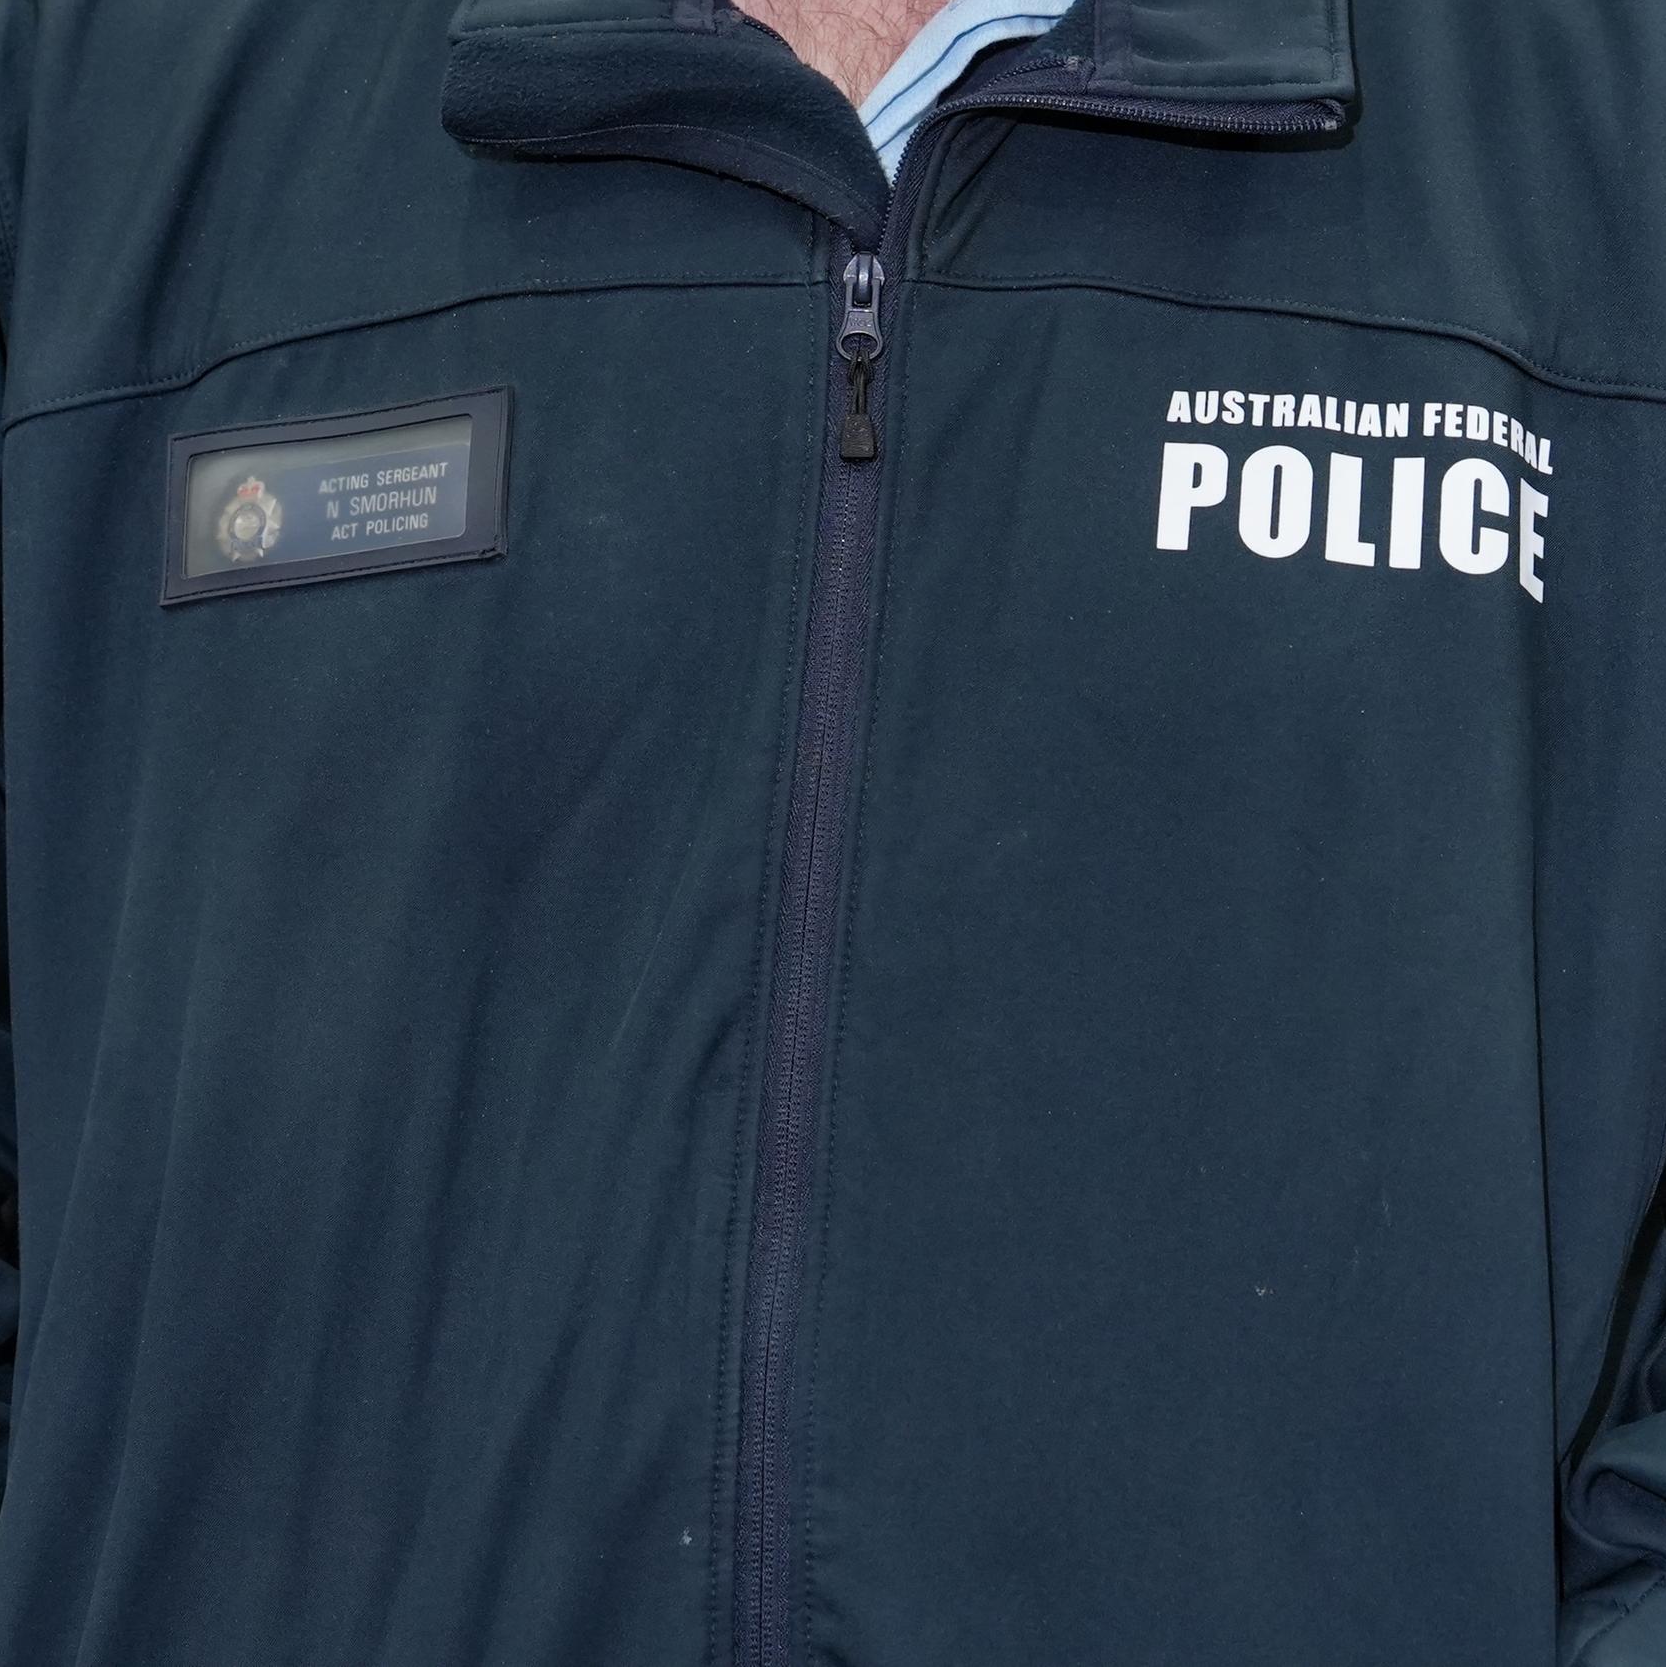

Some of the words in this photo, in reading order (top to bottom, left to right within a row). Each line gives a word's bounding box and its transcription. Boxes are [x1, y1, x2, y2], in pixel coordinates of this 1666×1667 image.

[1166, 390, 1410, 438] AUSTRALIAN
[1423, 401, 1554, 475] FEDERAL
[318, 473, 369, 494] ACTING
[376, 462, 448, 487] SERGEANT
[326, 500, 340, 519] N
[349, 486, 437, 516] SMORHUN
[331, 523, 358, 541] ACT
[366, 513, 429, 536] POLICING
[1156, 442, 1549, 604] POLICE
